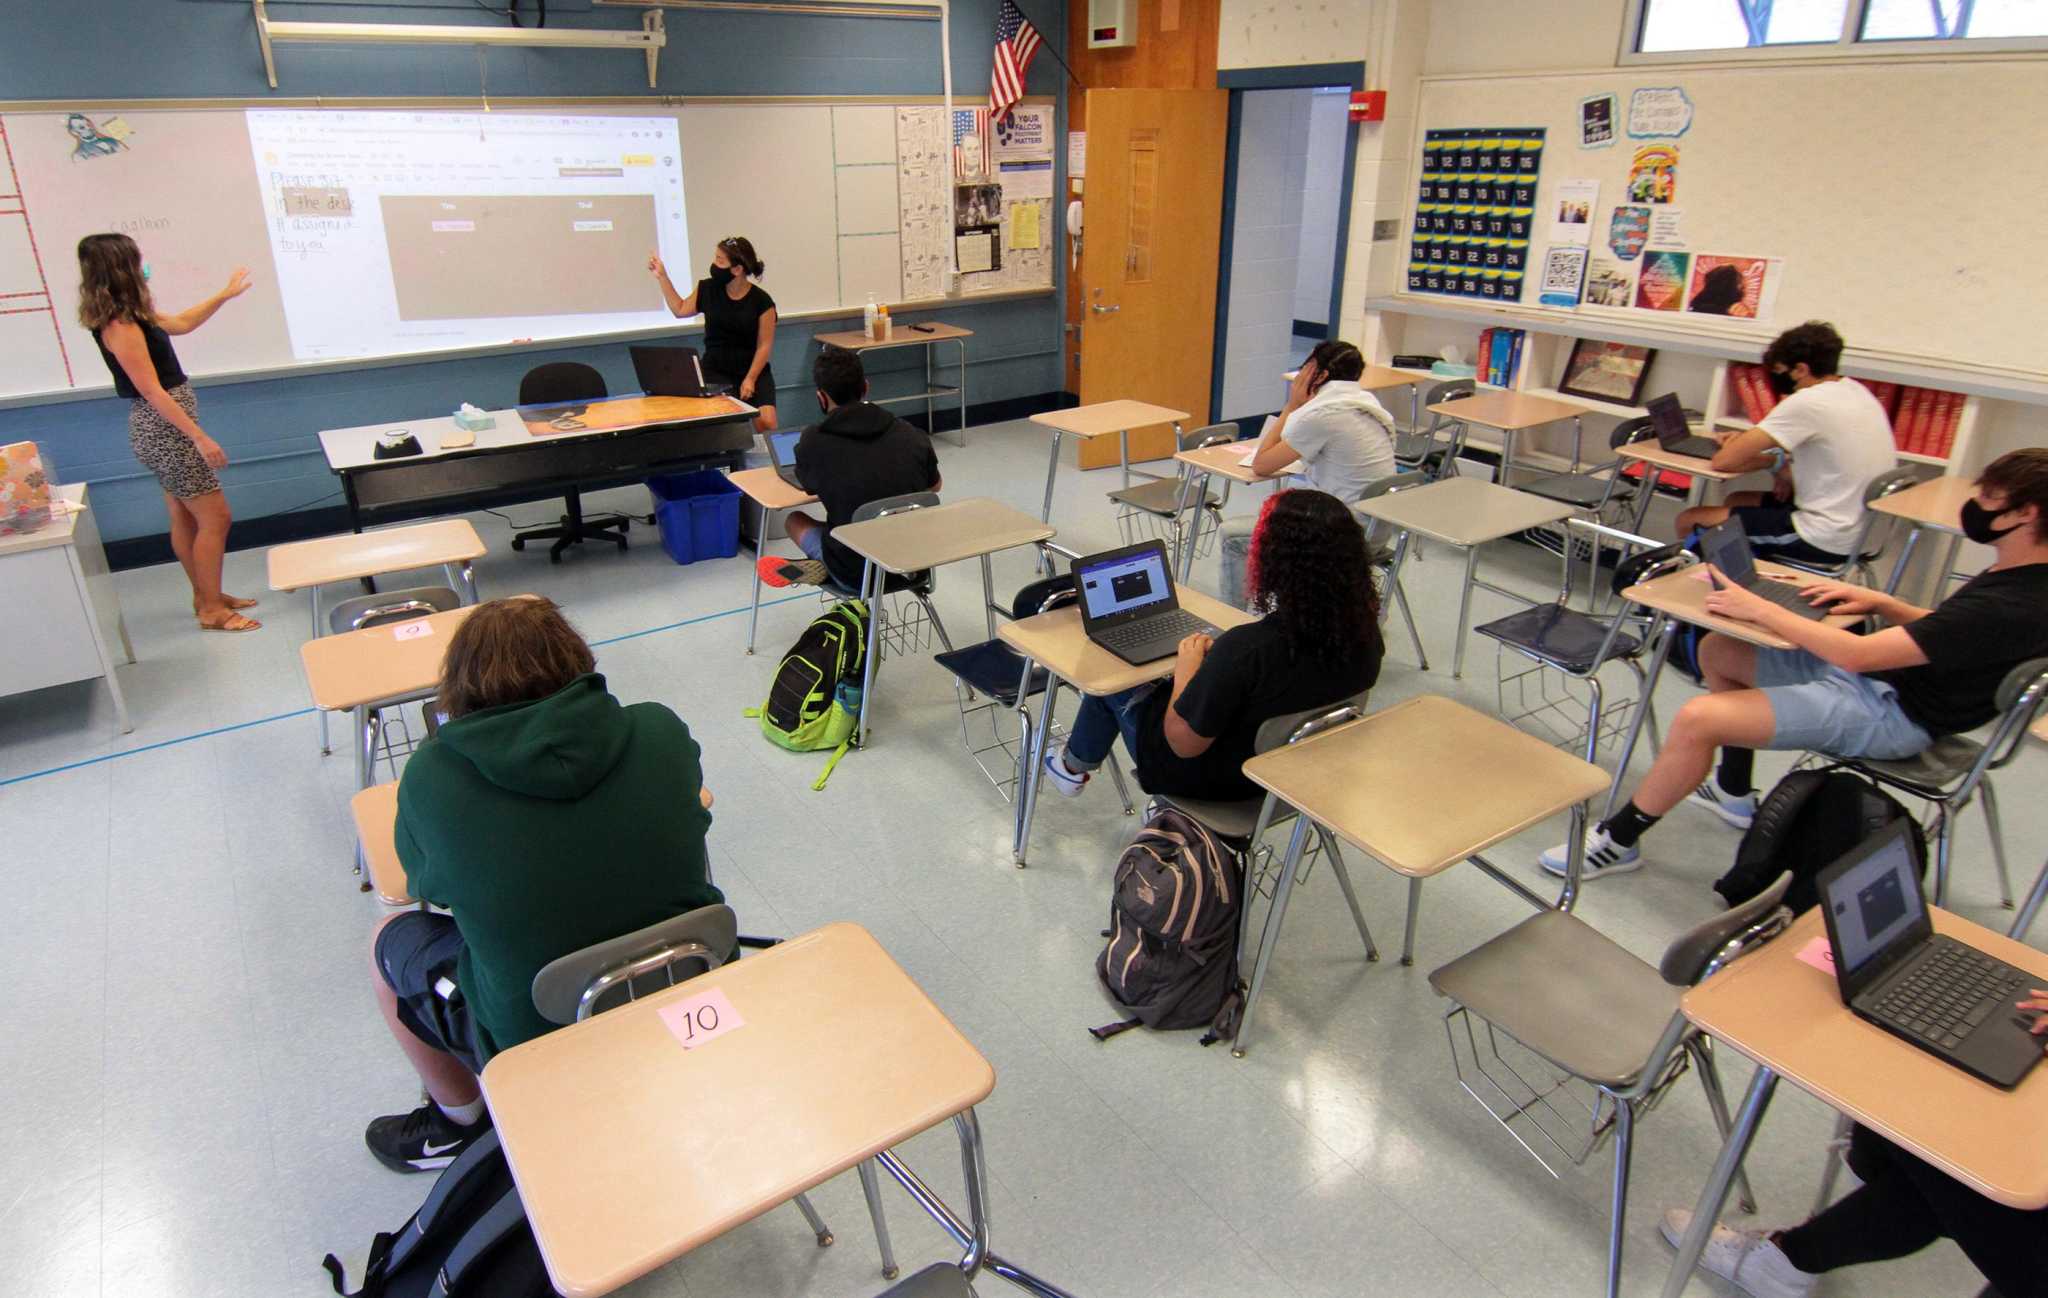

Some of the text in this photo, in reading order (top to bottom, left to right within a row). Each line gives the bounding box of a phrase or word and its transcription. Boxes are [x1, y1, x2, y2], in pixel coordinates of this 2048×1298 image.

[1018, 114, 1040, 123] YOUR
[1015, 123, 1042, 131] FALCON
[1424, 156, 1532, 168] 01 02 03 04 05 06
[1420, 188, 1527, 201] 07 08 09 10 11 12
[297, 195, 320, 210] the
[1417, 218, 1522, 233] 13 14 15 16 17 18
[1414, 248, 1518, 264] 19 20 21 22 23 24
[1410, 277, 1514, 295] 25 26 27 28 29 30
[683, 1004, 719, 1041] 10
